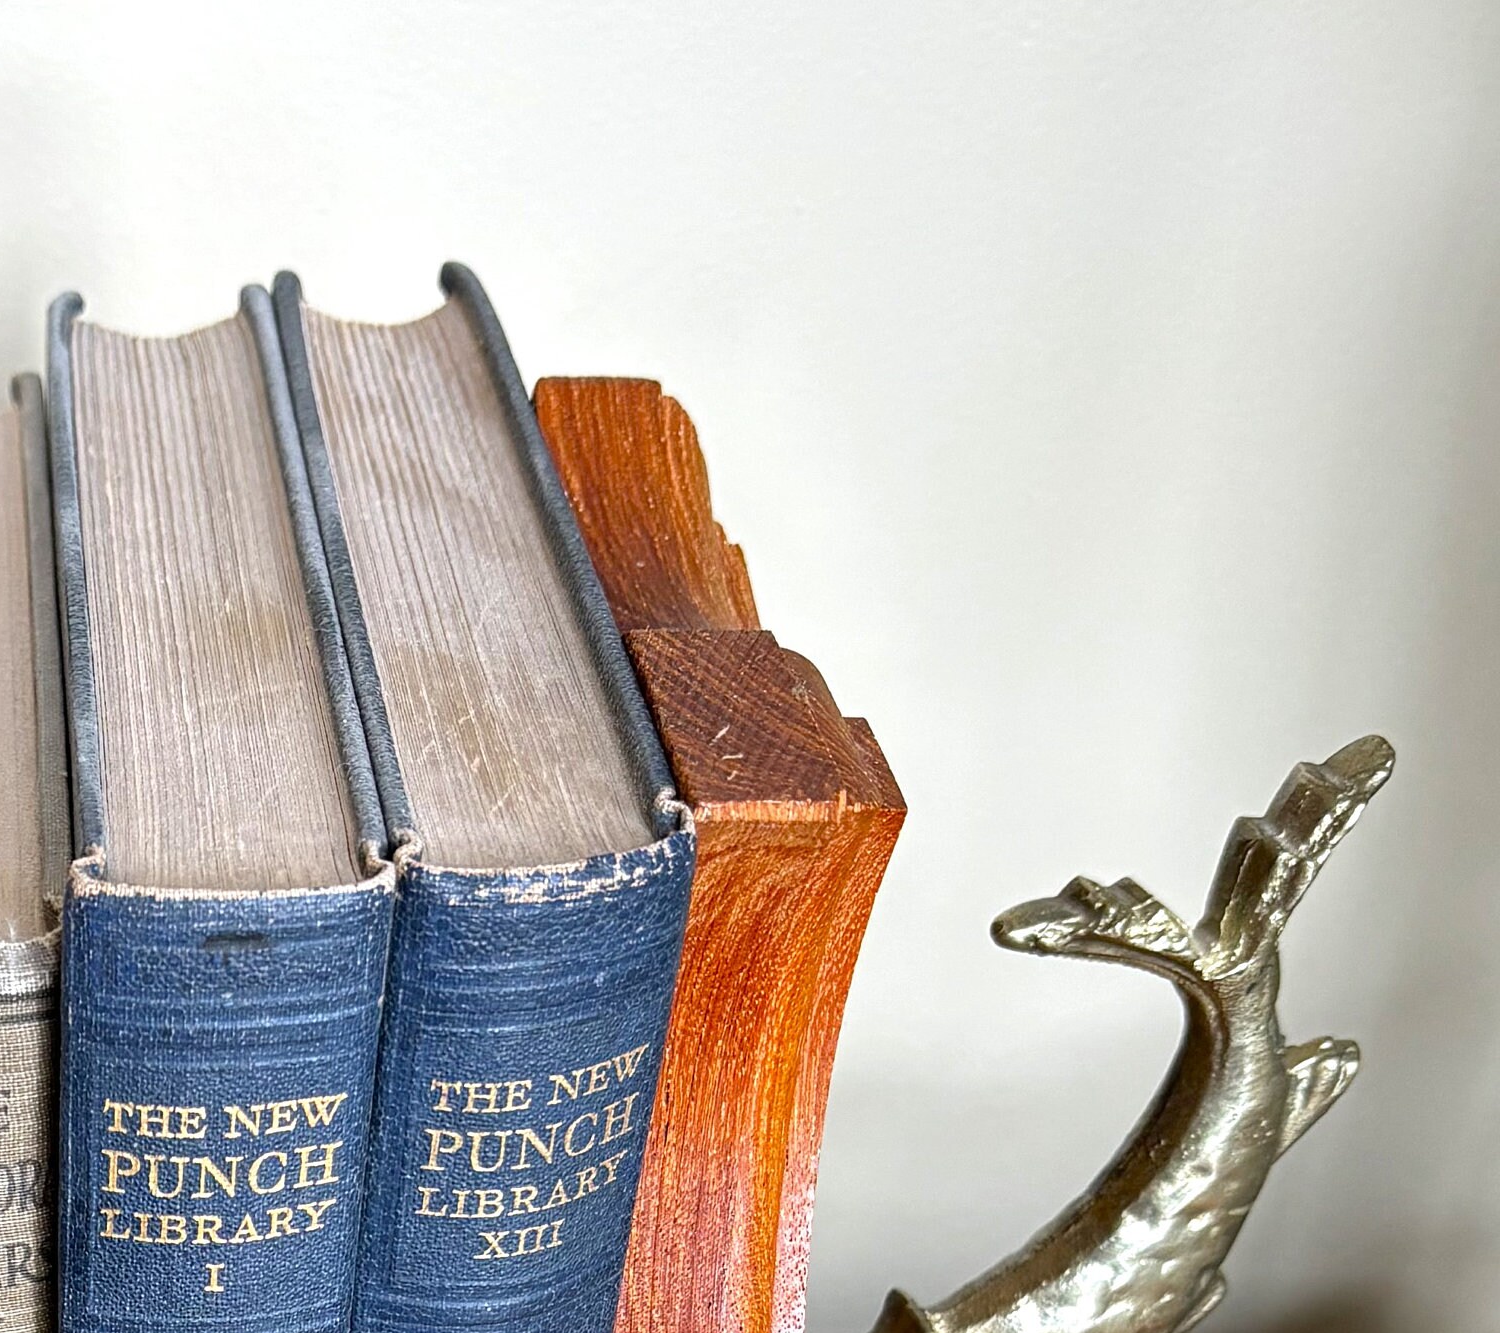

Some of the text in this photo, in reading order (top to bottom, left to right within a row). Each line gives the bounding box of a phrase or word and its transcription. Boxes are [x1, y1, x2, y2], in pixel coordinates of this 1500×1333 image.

[431, 1043, 650, 1114] THE NEW
[103, 1092, 348, 1139] THE NEW
[420, 1091, 640, 1173] PUNCH
[102, 1140, 344, 1199] PUNCH
[415, 1149, 629, 1218] LIBRARY
[100, 1199, 337, 1245] LIBRARY
[473, 1218, 566, 1260] XIII
[204, 1262, 225, 1293] I
